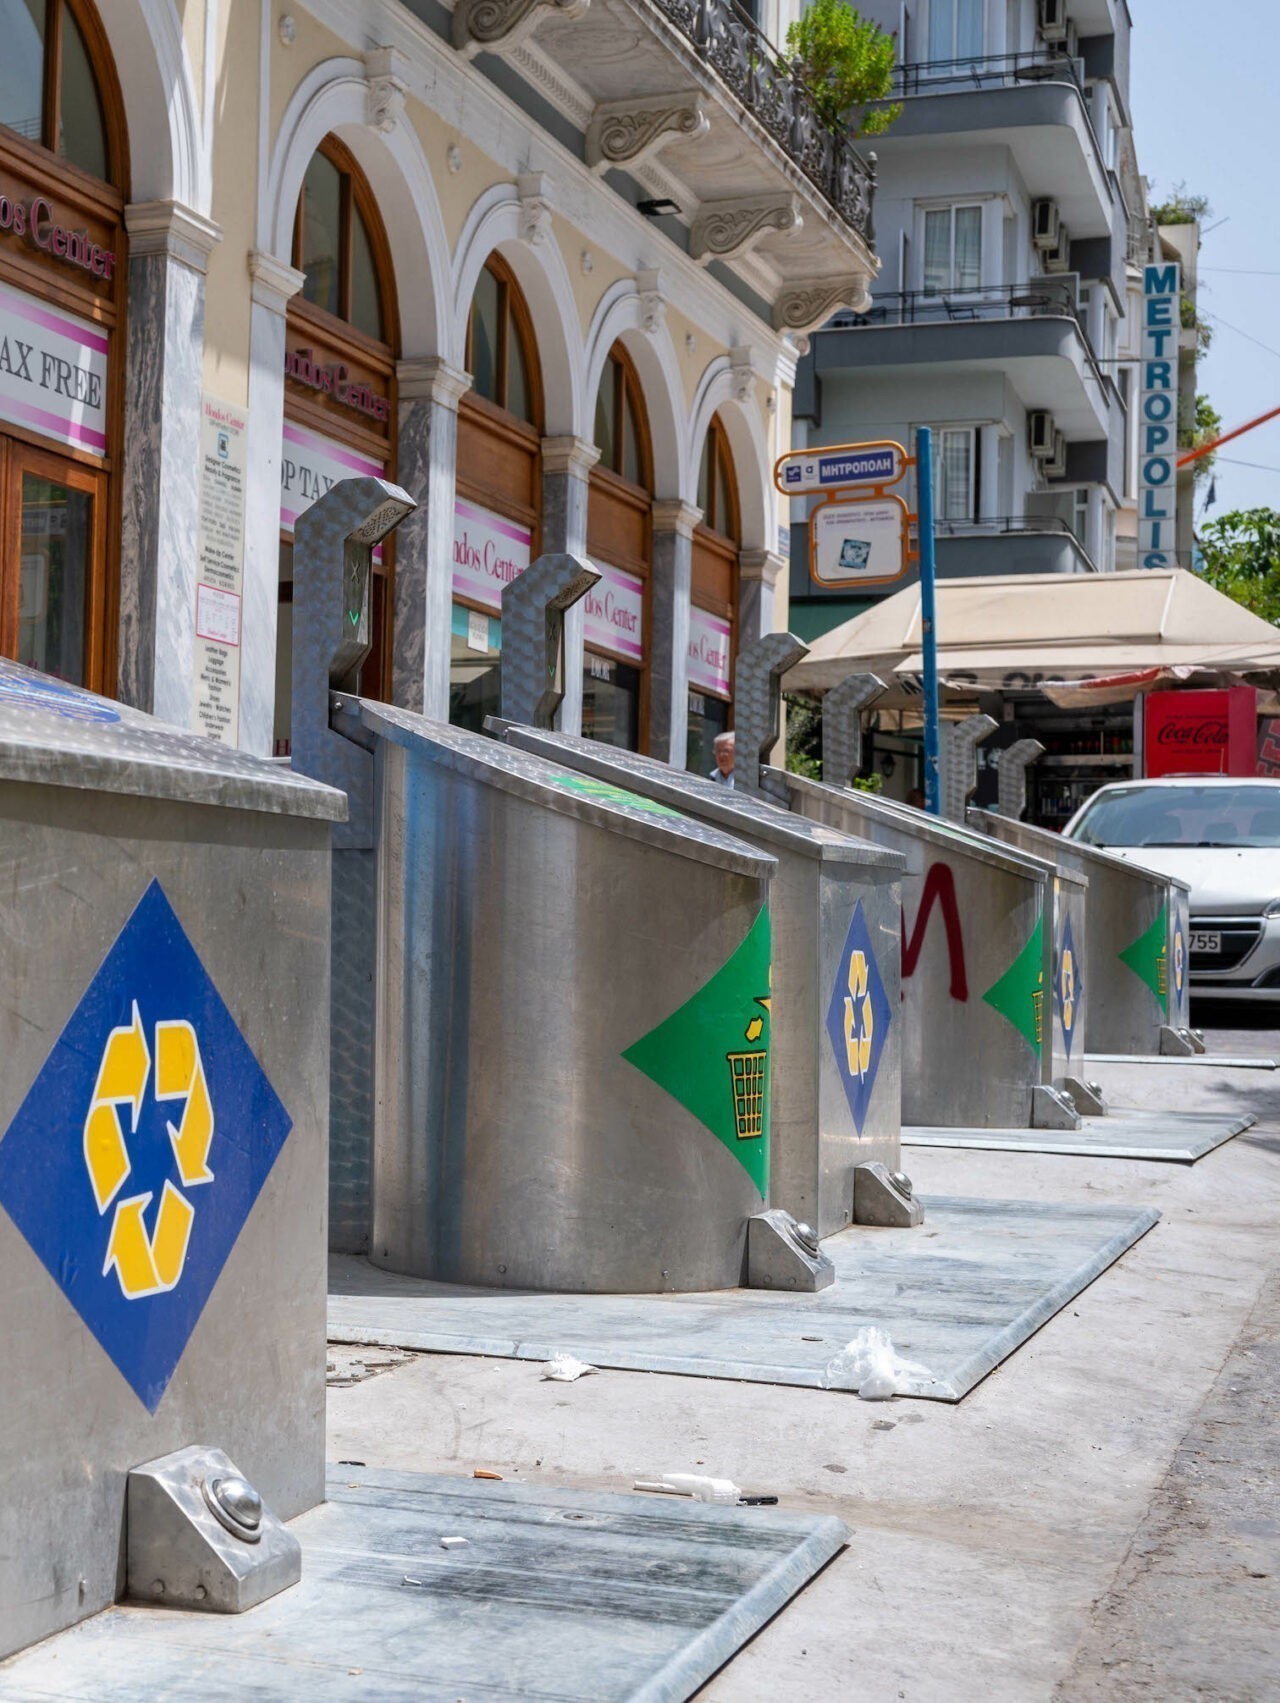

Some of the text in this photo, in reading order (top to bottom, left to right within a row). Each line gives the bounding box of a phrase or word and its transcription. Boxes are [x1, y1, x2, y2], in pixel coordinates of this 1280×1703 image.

[30, 197, 116, 280] Center
[40, 351, 101, 410] FREE
[334, 363, 391, 423] Center
[1143, 264, 1177, 569] METROPOLIS
[821, 458, 891, 477] ΜΗΤΡΟΠΟΛΗ
[605, 590, 637, 632] Center
